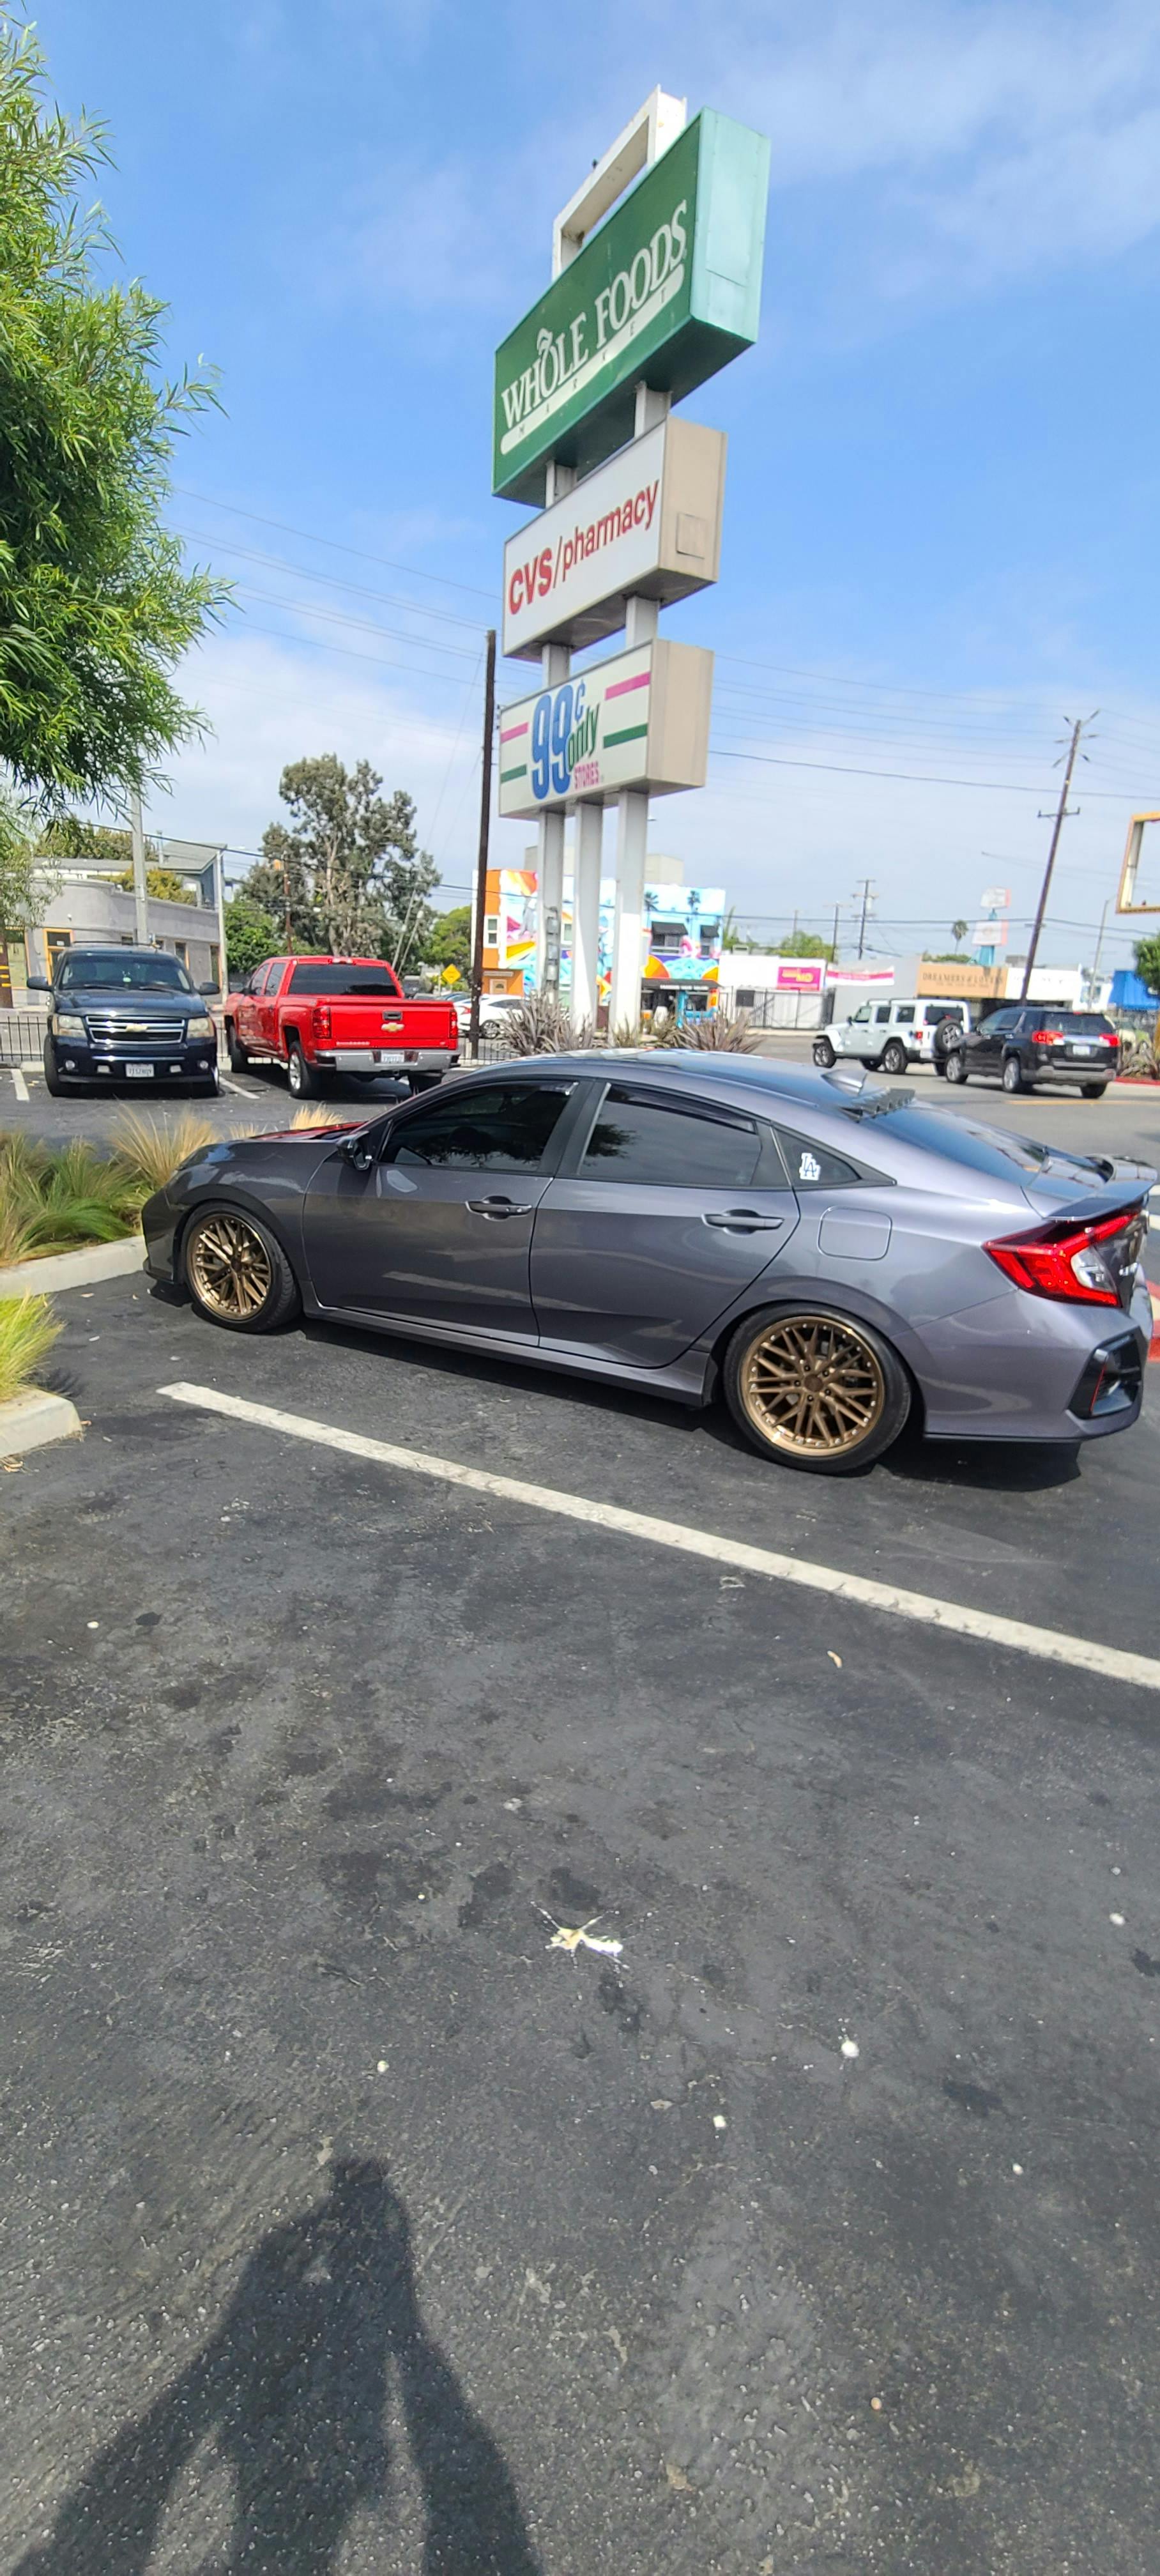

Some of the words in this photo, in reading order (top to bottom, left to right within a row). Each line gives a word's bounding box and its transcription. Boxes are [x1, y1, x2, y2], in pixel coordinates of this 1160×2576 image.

[501, 311, 589, 429] WHOLE
[594, 199, 687, 349] FOODS
[567, 702, 600, 773] only
[574, 760, 599, 790] STORES
[802, 1154, 818, 1179] LA
